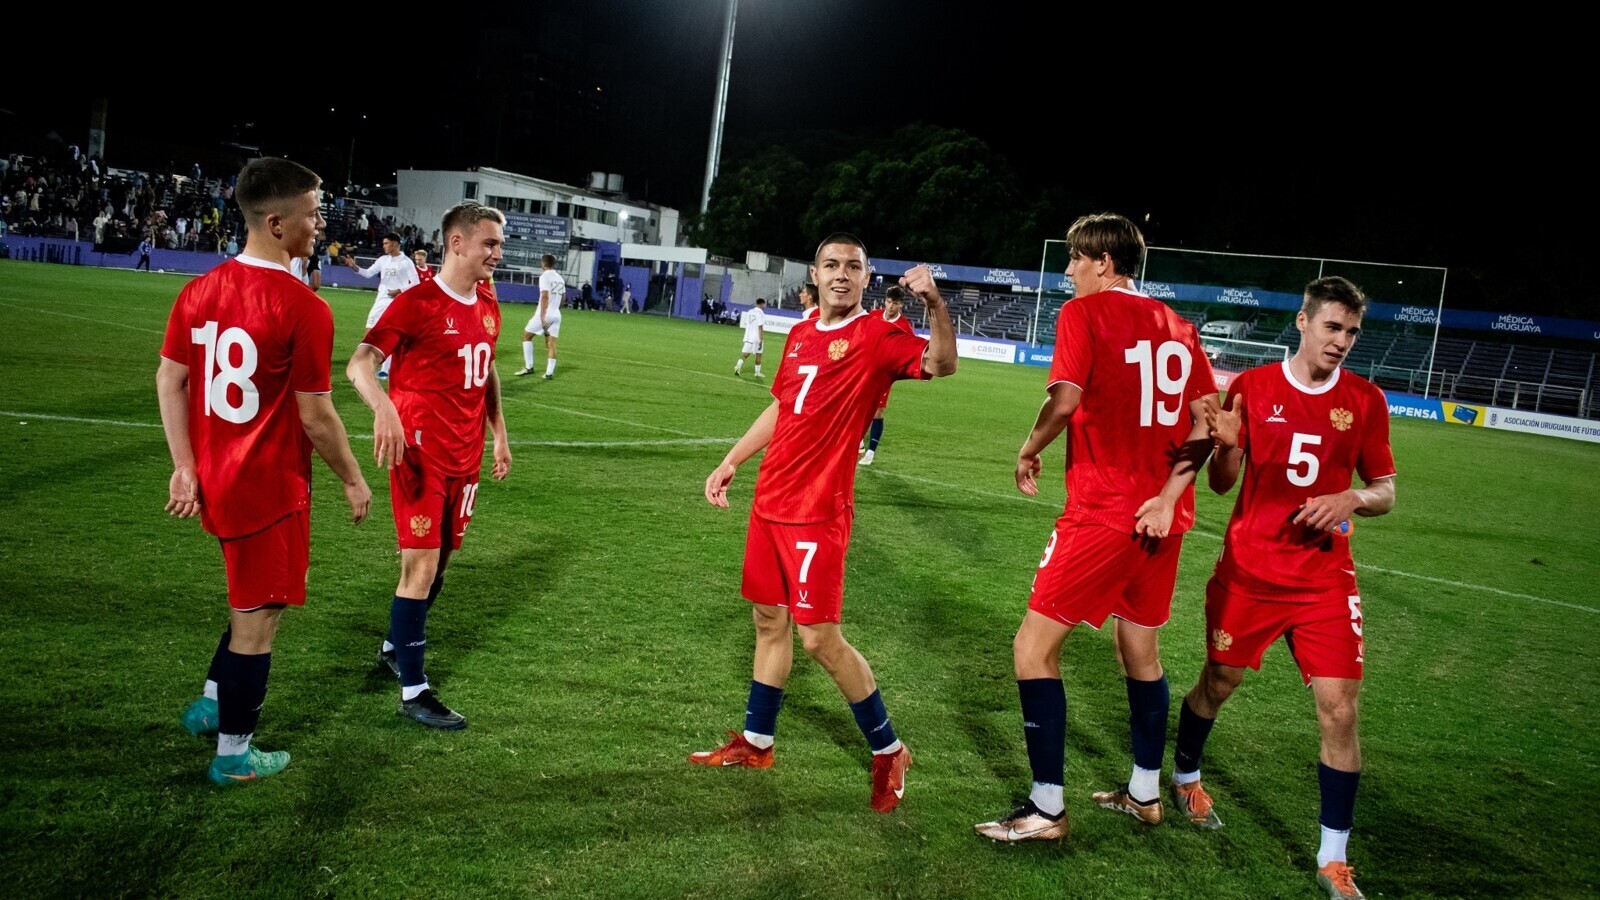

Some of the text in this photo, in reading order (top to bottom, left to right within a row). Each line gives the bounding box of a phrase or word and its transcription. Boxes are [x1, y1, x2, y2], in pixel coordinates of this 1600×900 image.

[989, 268, 1015, 277] MÉDICA
[983, 275, 1021, 285] URUGUAYA
[1217, 295, 1259, 306] URUGUAYA
[1223, 288, 1253, 299] MÉDICA
[1401, 306, 1435, 316] MÉDICA
[1394, 313, 1442, 325] URUGUAYA
[1499, 313, 1534, 325] MÉDICA
[1491, 322, 1541, 333] URUGUAYA
[977, 345, 1007, 355] casmu
[190, 320, 259, 424] 18
[458, 342, 491, 389] 10
[793, 364, 818, 414] 7
[1125, 340, 1192, 427] 19
[1389, 404, 1438, 420] MPENSA
[1503, 416, 1540, 428] ASOCIACIÓN
[1540, 421, 1572, 432] URUGUAYA
[1572, 425, 1581, 434] DE
[1286, 432, 1322, 487] 5
[795, 541, 818, 583] 7
[1347, 595, 1362, 637] 5
